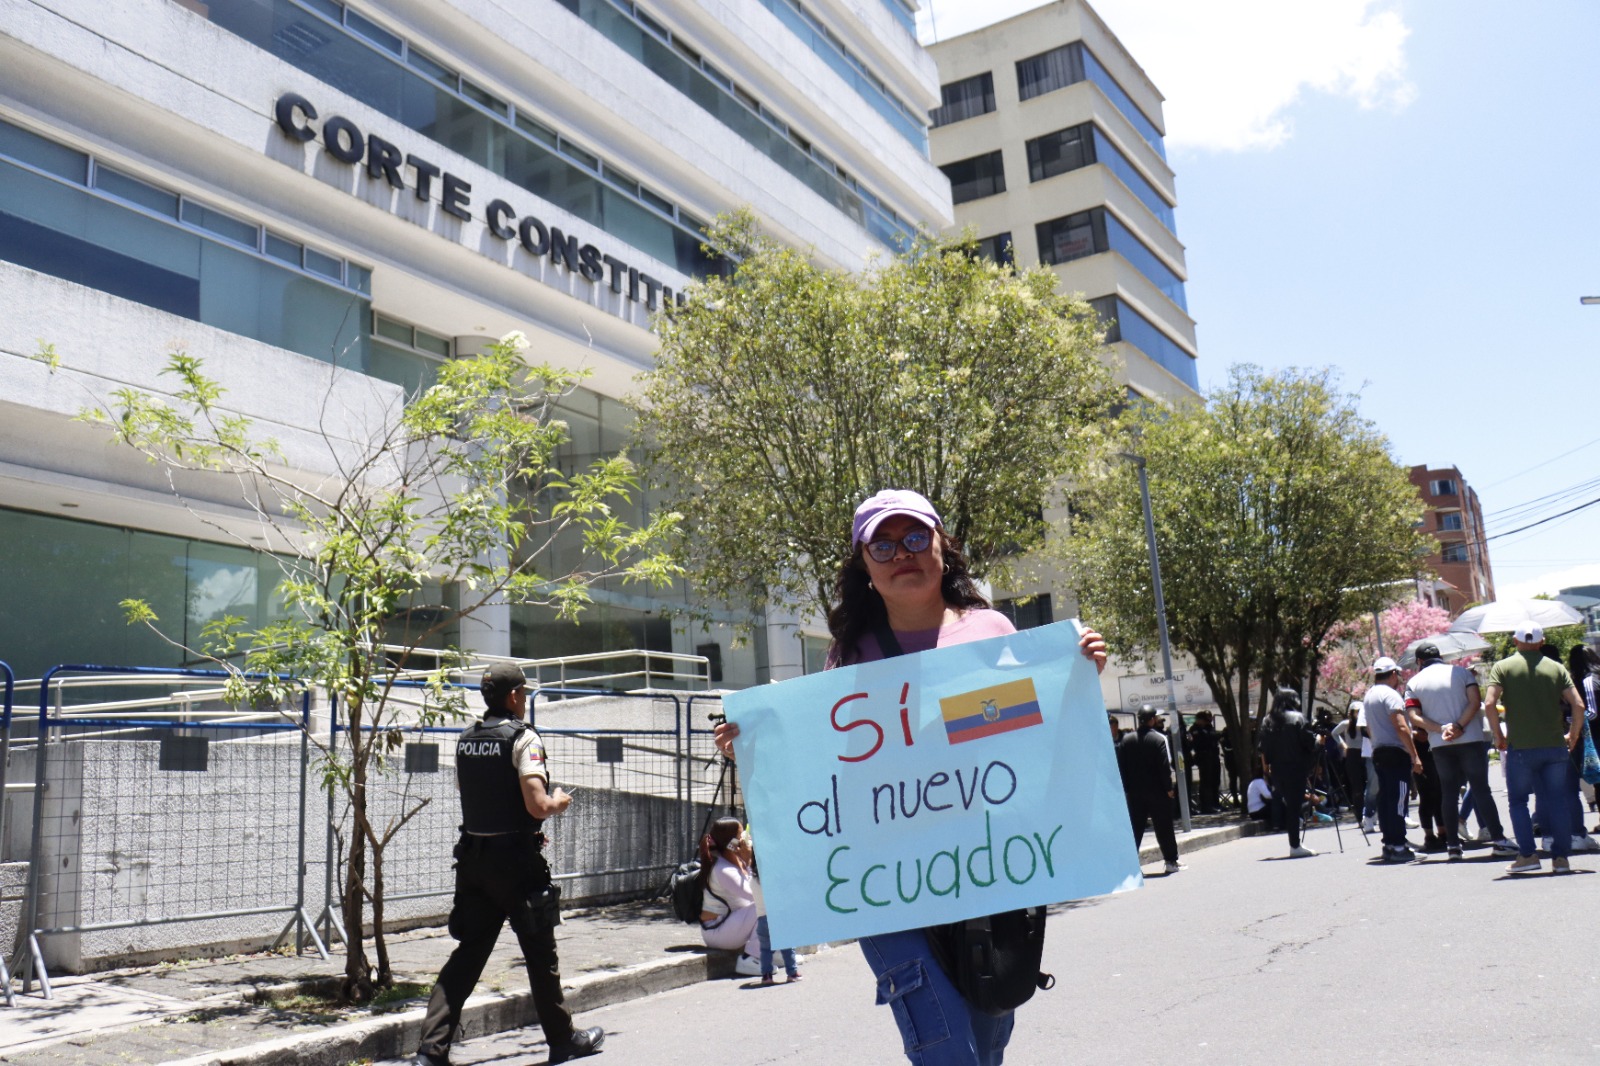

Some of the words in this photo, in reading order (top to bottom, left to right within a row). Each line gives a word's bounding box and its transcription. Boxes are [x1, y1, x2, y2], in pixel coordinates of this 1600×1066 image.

[275, 92, 472, 222] CORTE
[1150, 674, 1185, 685] MONALT
[457, 741, 502, 756] POLICIA
[796, 774, 841, 837] al
[872, 760, 1017, 825] nuevo
[825, 810, 1063, 914] Ecuador
